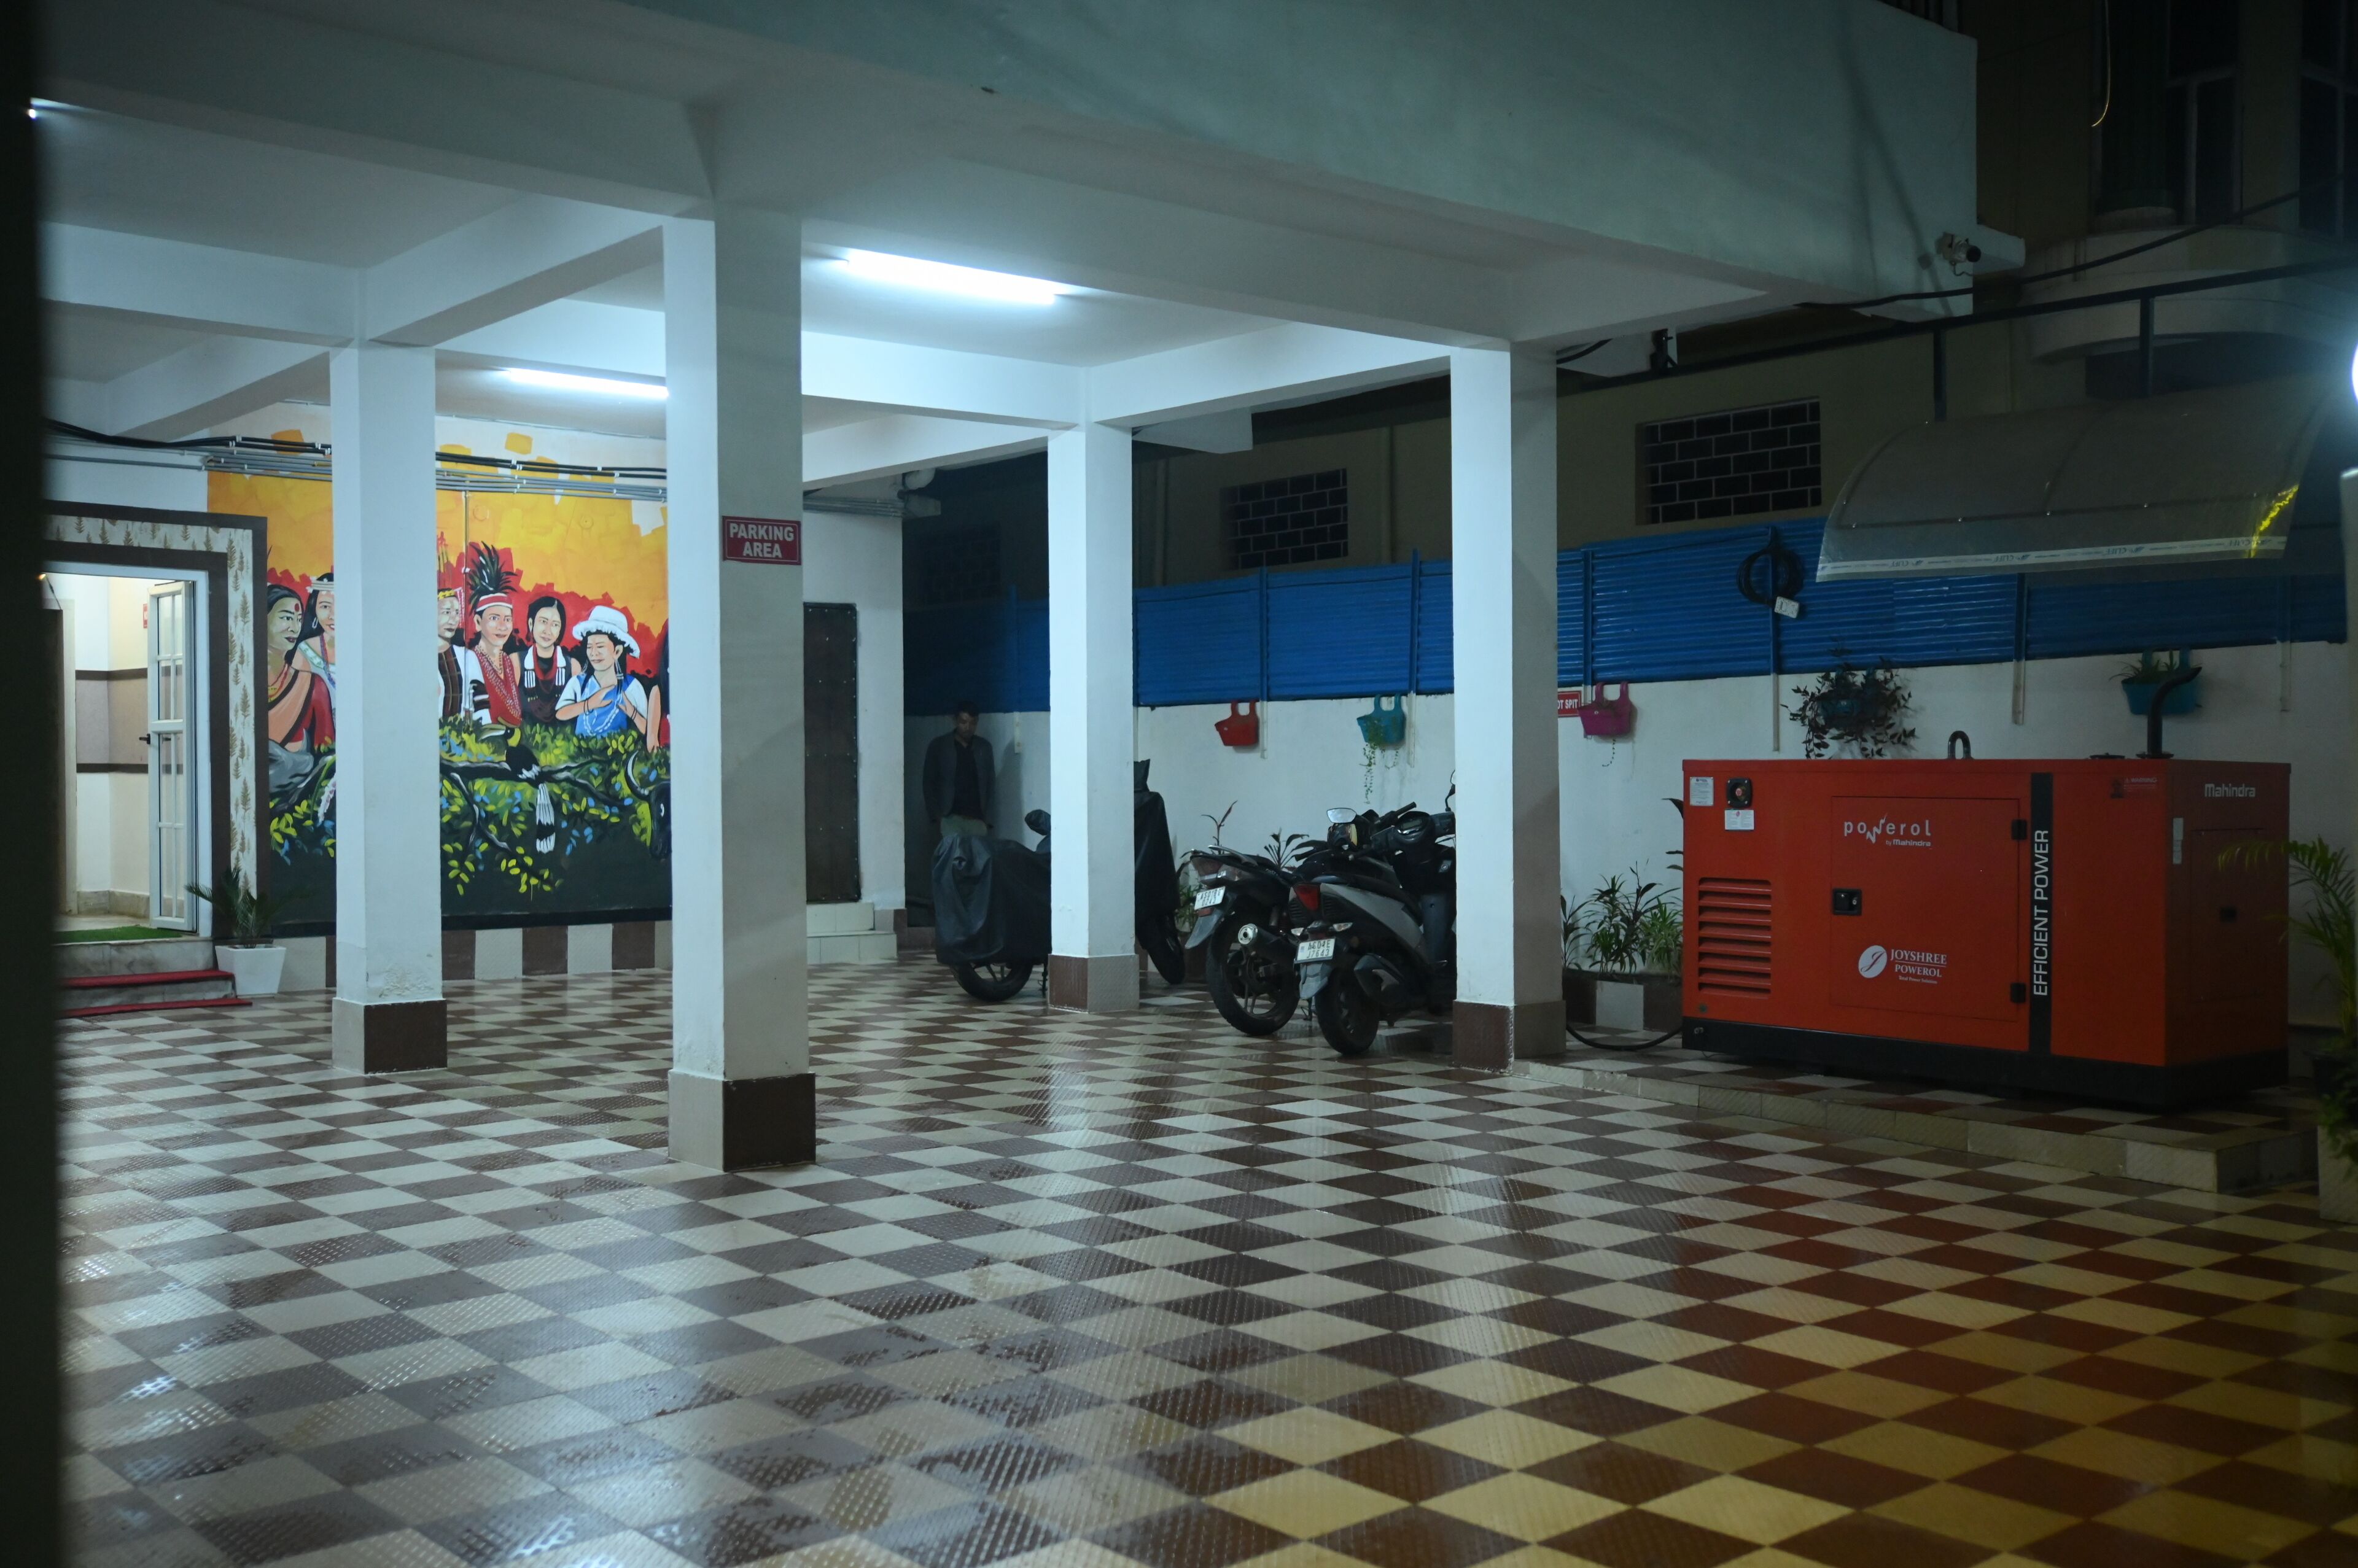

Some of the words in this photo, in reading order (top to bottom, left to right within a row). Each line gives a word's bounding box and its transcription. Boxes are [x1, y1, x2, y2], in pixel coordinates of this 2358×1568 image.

[730, 522, 795, 541] PARKING
[742, 541, 782, 558] AREA
[1565, 699, 1578, 709] SPIT
[2204, 783, 2255, 797] Mahindra
[2034, 830, 2049, 900] POWER
[1891, 949, 1947, 964] JOYSHREE
[2034, 905, 2048, 995] EFFICIENT
[1895, 964, 1942, 977] POWEROL
